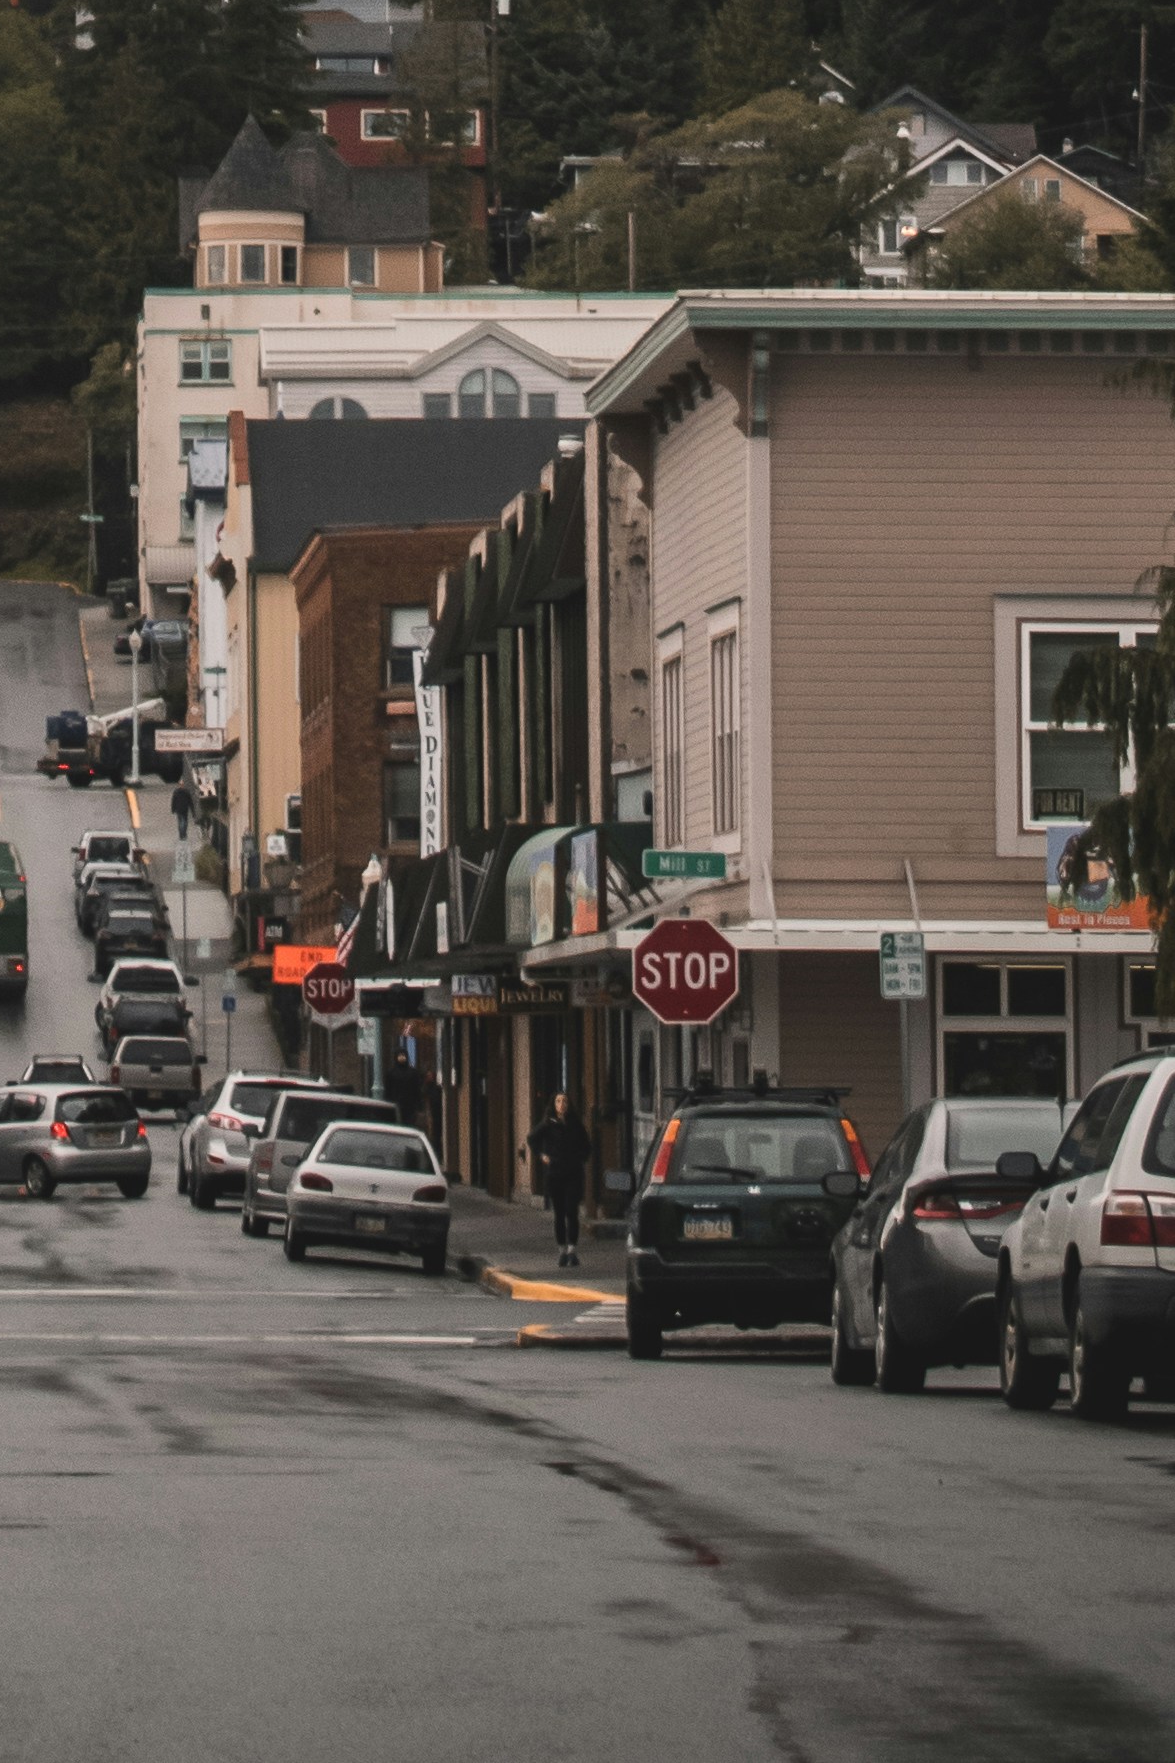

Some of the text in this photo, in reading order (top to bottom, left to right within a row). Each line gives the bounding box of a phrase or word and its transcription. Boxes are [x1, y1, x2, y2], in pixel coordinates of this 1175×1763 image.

[659, 855, 686, 871] Mill
[882, 936, 893, 954] 2
[300, 951, 324, 962] END
[277, 966, 307, 978] ROAD
[640, 952, 730, 990] STOP
[307, 978, 352, 998] STOP
